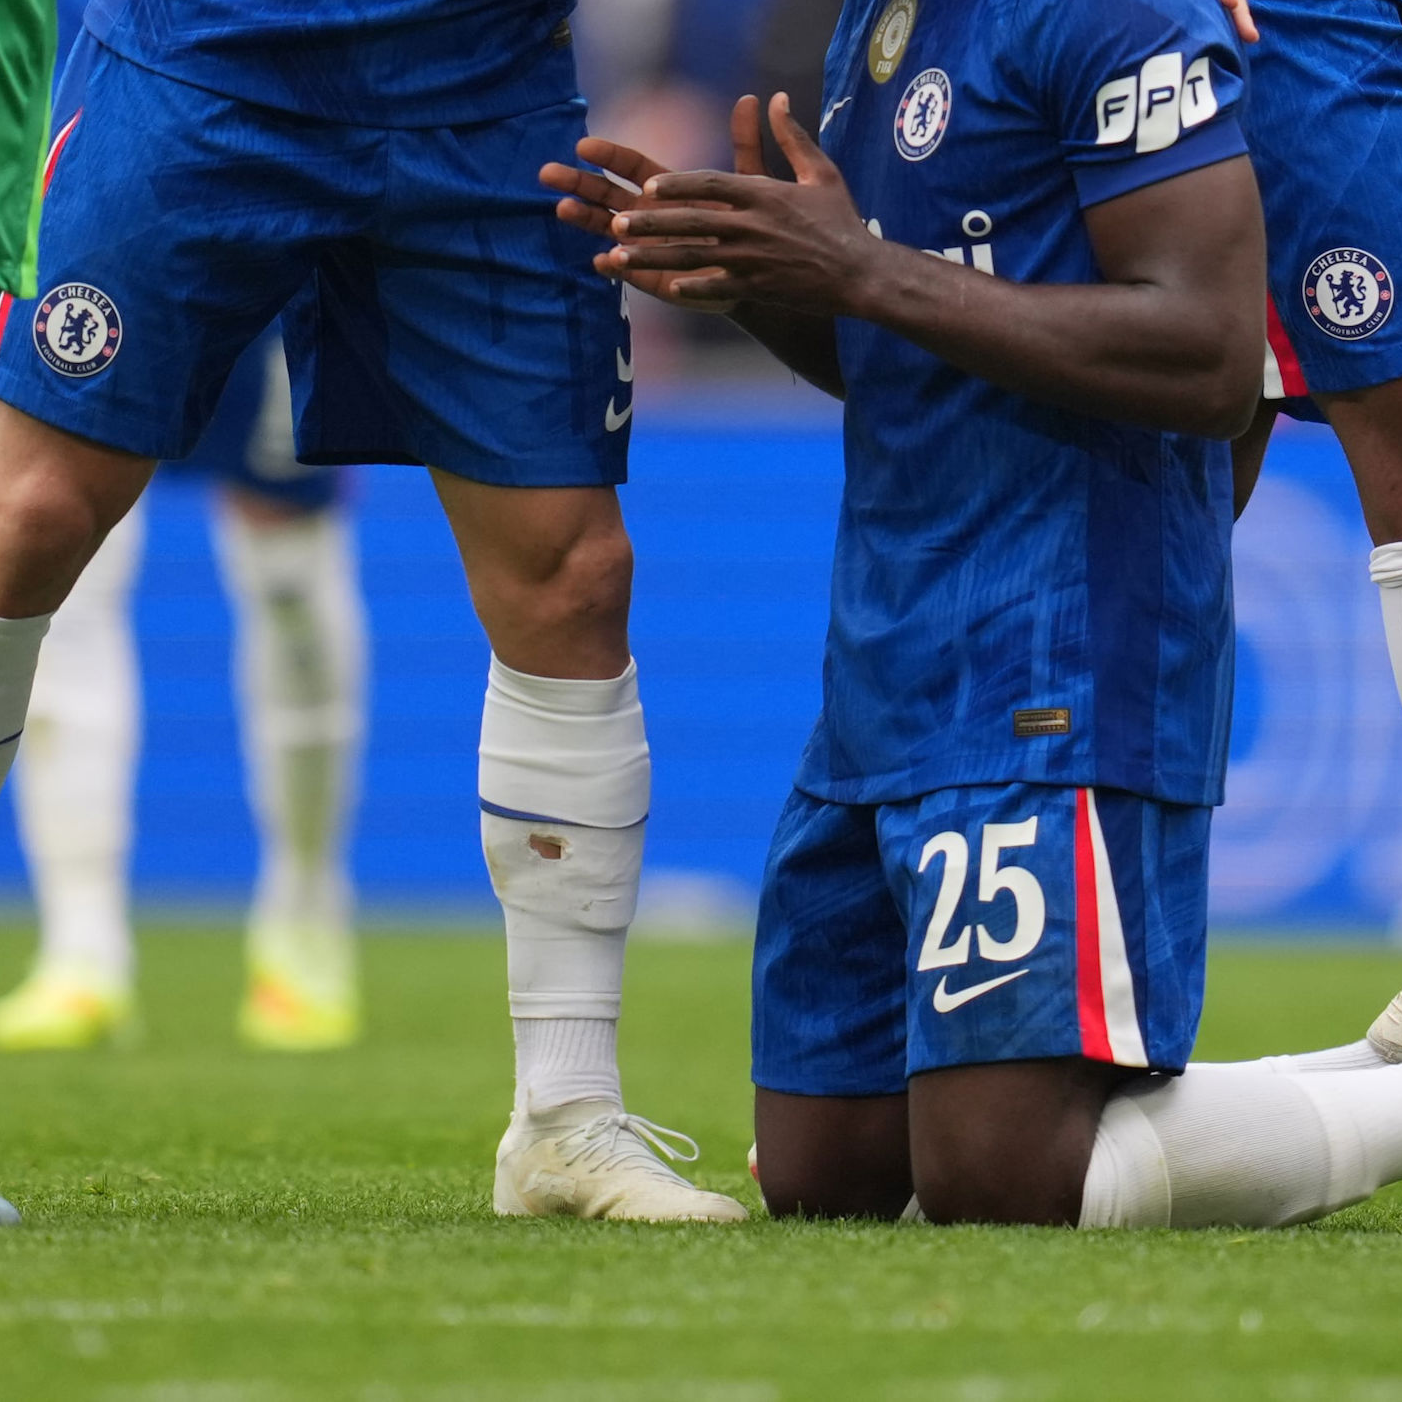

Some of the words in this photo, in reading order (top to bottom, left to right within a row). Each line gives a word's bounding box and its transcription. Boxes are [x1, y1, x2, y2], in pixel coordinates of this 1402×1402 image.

[1103, 75, 1204, 129] FPT
[1312, 250, 1368, 277] CHELSEA
[58, 286, 112, 316] CHELSEA
[1325, 323, 1364, 336] FOOTBALL
[1366, 312, 1383, 329] CLUB
[41, 344, 73, 371] FOOTBALL
[916, 814, 1046, 972] 25
